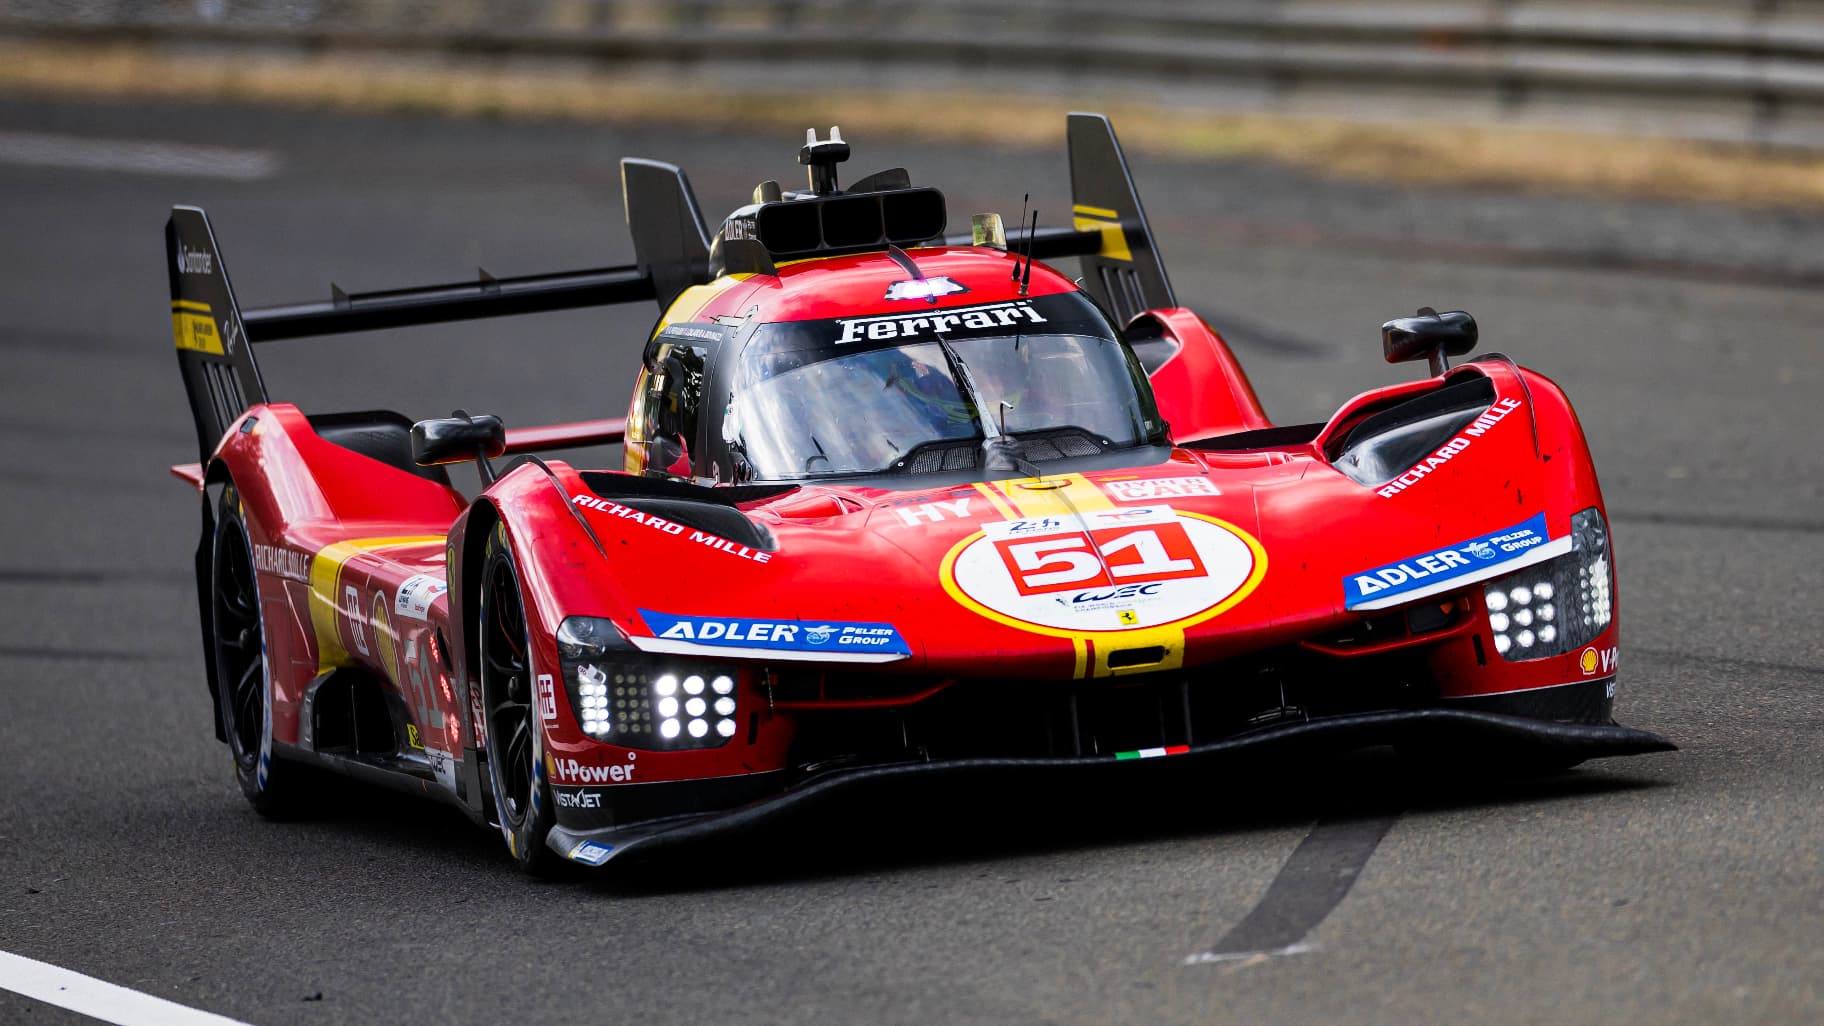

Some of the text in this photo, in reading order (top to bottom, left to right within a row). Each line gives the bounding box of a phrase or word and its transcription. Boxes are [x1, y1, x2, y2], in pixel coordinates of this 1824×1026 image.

[834, 300, 1048, 344] Ferrari
[1376, 397, 1522, 498] RICHARD MILLE
[896, 498, 971, 527] HY
[572, 494, 772, 563] RICHARD MILLE
[1489, 529, 1534, 546] PELZER
[1500, 536, 1543, 553] GROUP
[255, 544, 287, 576] RICHARD
[1008, 530, 1195, 588] 51
[1354, 549, 1471, 596] ADLER
[1072, 583, 1163, 604] WEC
[659, 621, 799, 642] ADLER
[838, 635, 890, 645] GROUP
[843, 626, 894, 636] PELZER
[555, 757, 635, 782] V-Power
